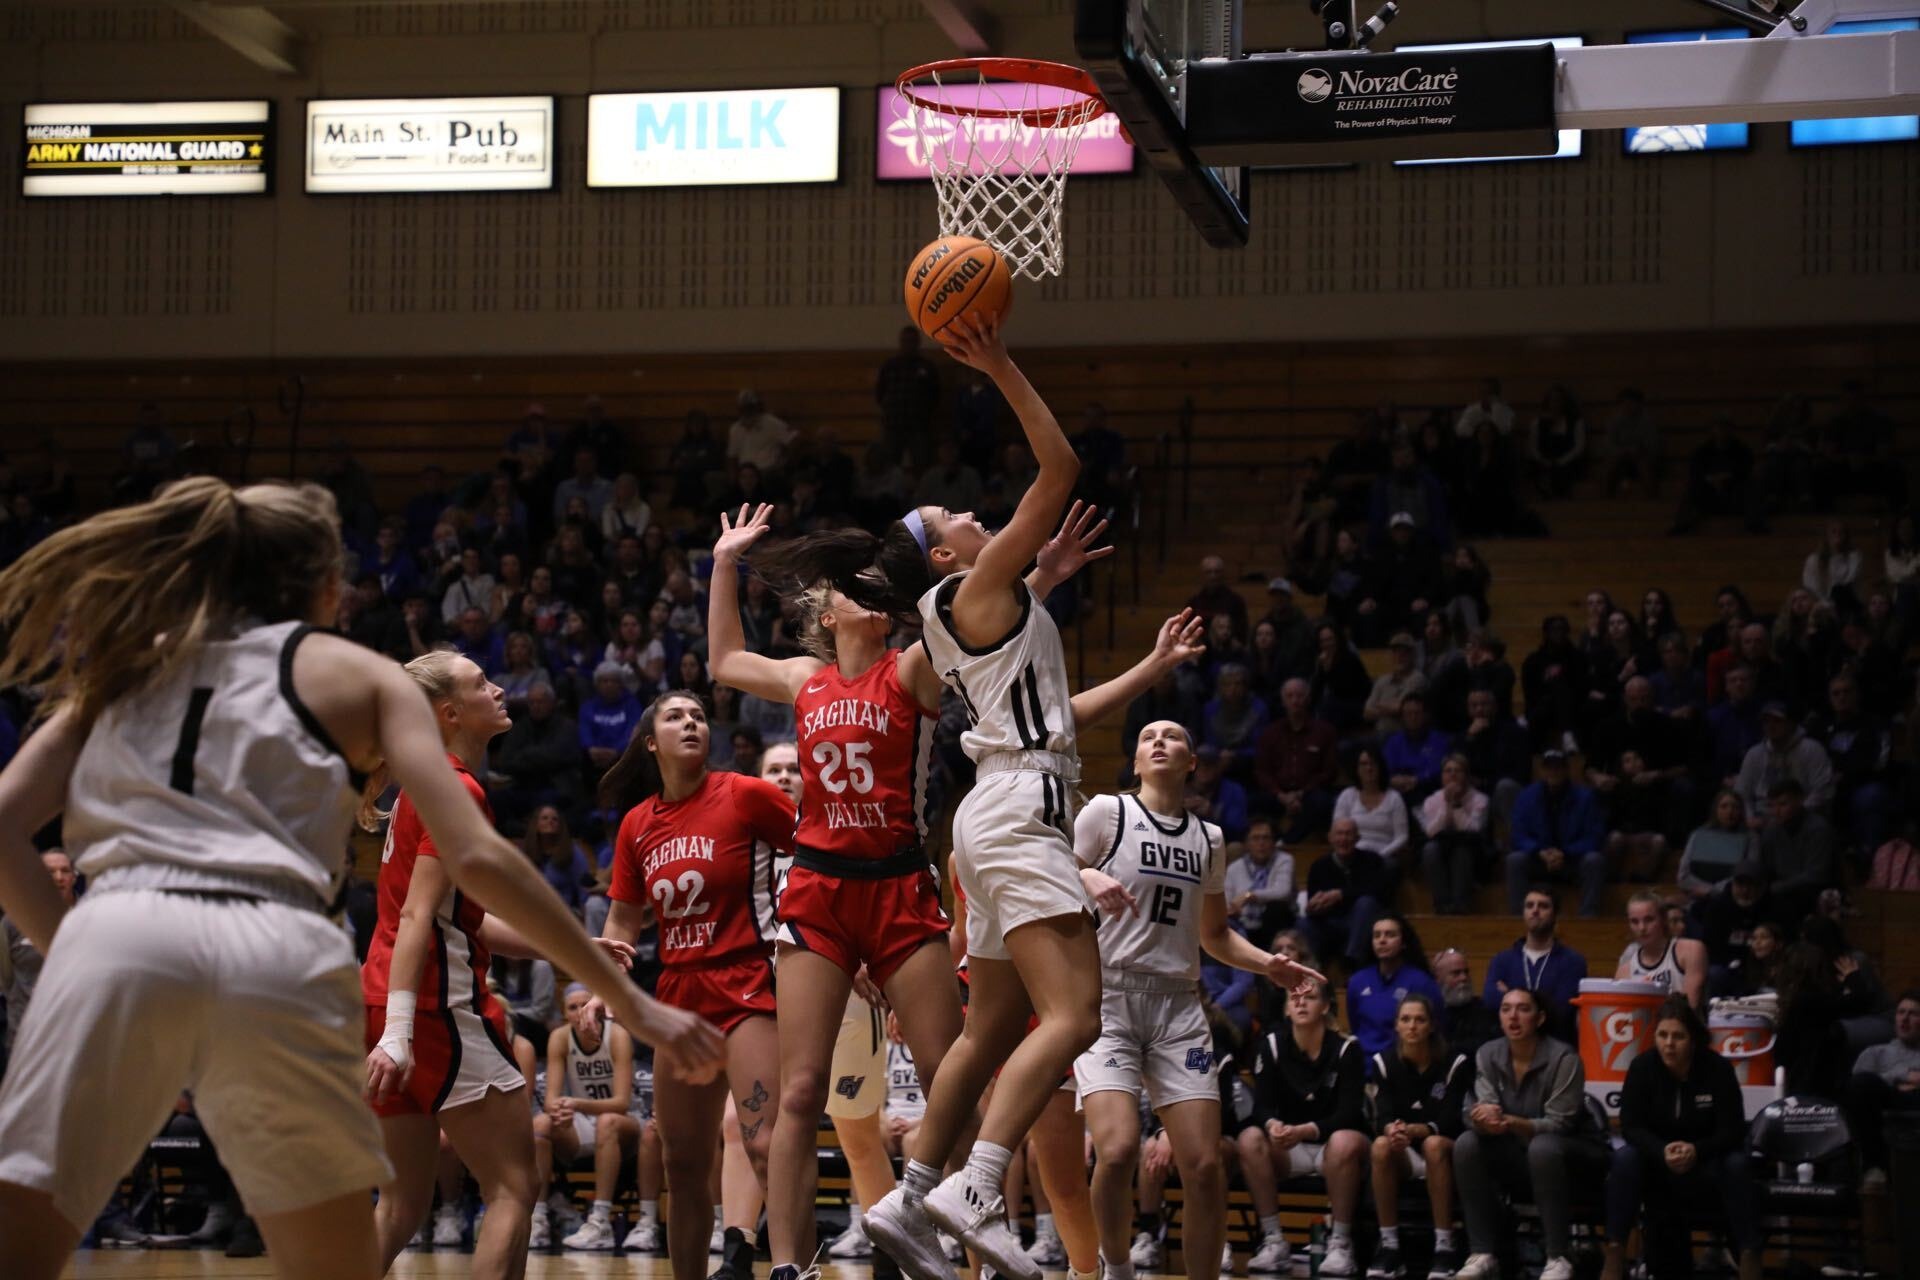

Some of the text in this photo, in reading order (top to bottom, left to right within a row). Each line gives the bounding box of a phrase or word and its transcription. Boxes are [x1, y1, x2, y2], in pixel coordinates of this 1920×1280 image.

[1335, 68, 1458, 95] NovaCare
[1335, 115, 1453, 129] The Power of Physical Therapy
[1336, 96, 1453, 111] REHABILITATION
[27, 125, 91, 139] MICHIGAN
[324, 120, 519, 147] Main St. Pub
[635, 99, 787, 151] MILK
[27, 141, 246, 162] ARMY NATIONAL GUARD
[912, 244, 951, 290] NCAA
[928, 257, 985, 314] Wilson
[804, 699, 890, 741] SAGINAW
[170, 688, 214, 796] 1
[812, 741, 875, 794] 25
[824, 802, 888, 829] VALLEY
[642, 836, 715, 882] SAGINAW
[1141, 841, 1201, 877] GVSU
[652, 869, 711, 919] 22
[1150, 884, 1183, 926] 12
[576, 1060, 614, 1076] GVSU
